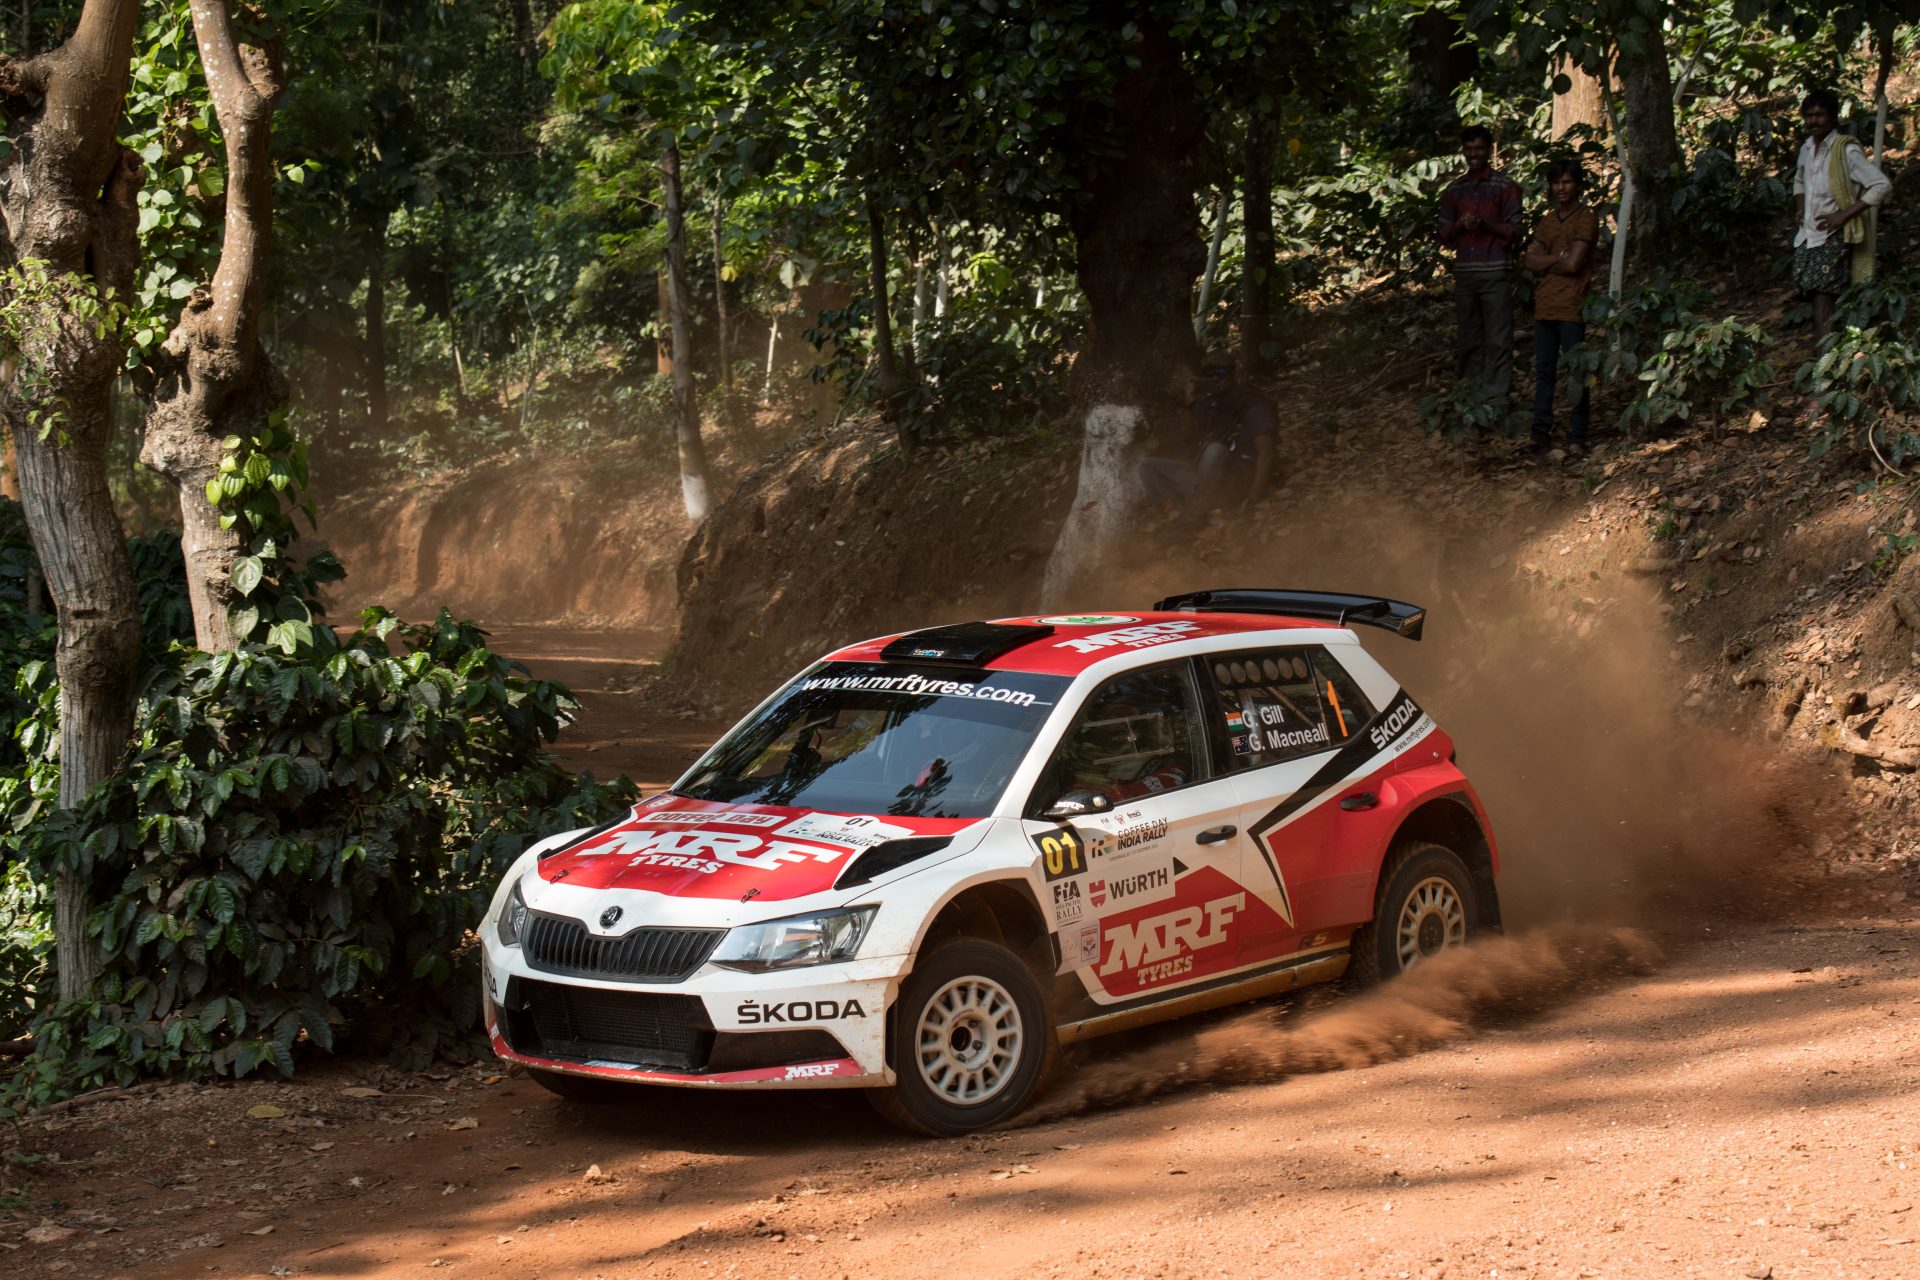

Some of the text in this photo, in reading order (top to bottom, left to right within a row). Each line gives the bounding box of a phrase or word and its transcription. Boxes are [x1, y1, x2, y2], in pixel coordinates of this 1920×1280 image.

[1052, 620, 1202, 654] MRF
[1124, 633, 1187, 648] TYRES
[802, 674, 1036, 707] www.mrftyres.com
[1241, 704, 1284, 728] G. Gill
[1370, 698, 1418, 750] ŠKODA
[1248, 722, 1329, 751] G. Macneall
[846, 817, 873, 827] 01
[1117, 817, 1168, 839] COFFEE DAY
[575, 830, 843, 870] MRF
[1117, 826, 1168, 851] INDIA RALLY
[628, 854, 724, 874] TYRES
[1041, 831, 1079, 875] 01
[1056, 904, 1082, 920] RALLY
[1100, 892, 1245, 977] MRF
[1137, 954, 1194, 986] TYRES
[737, 999, 867, 1024] ŠKODA
[785, 1063, 840, 1079] MRF
